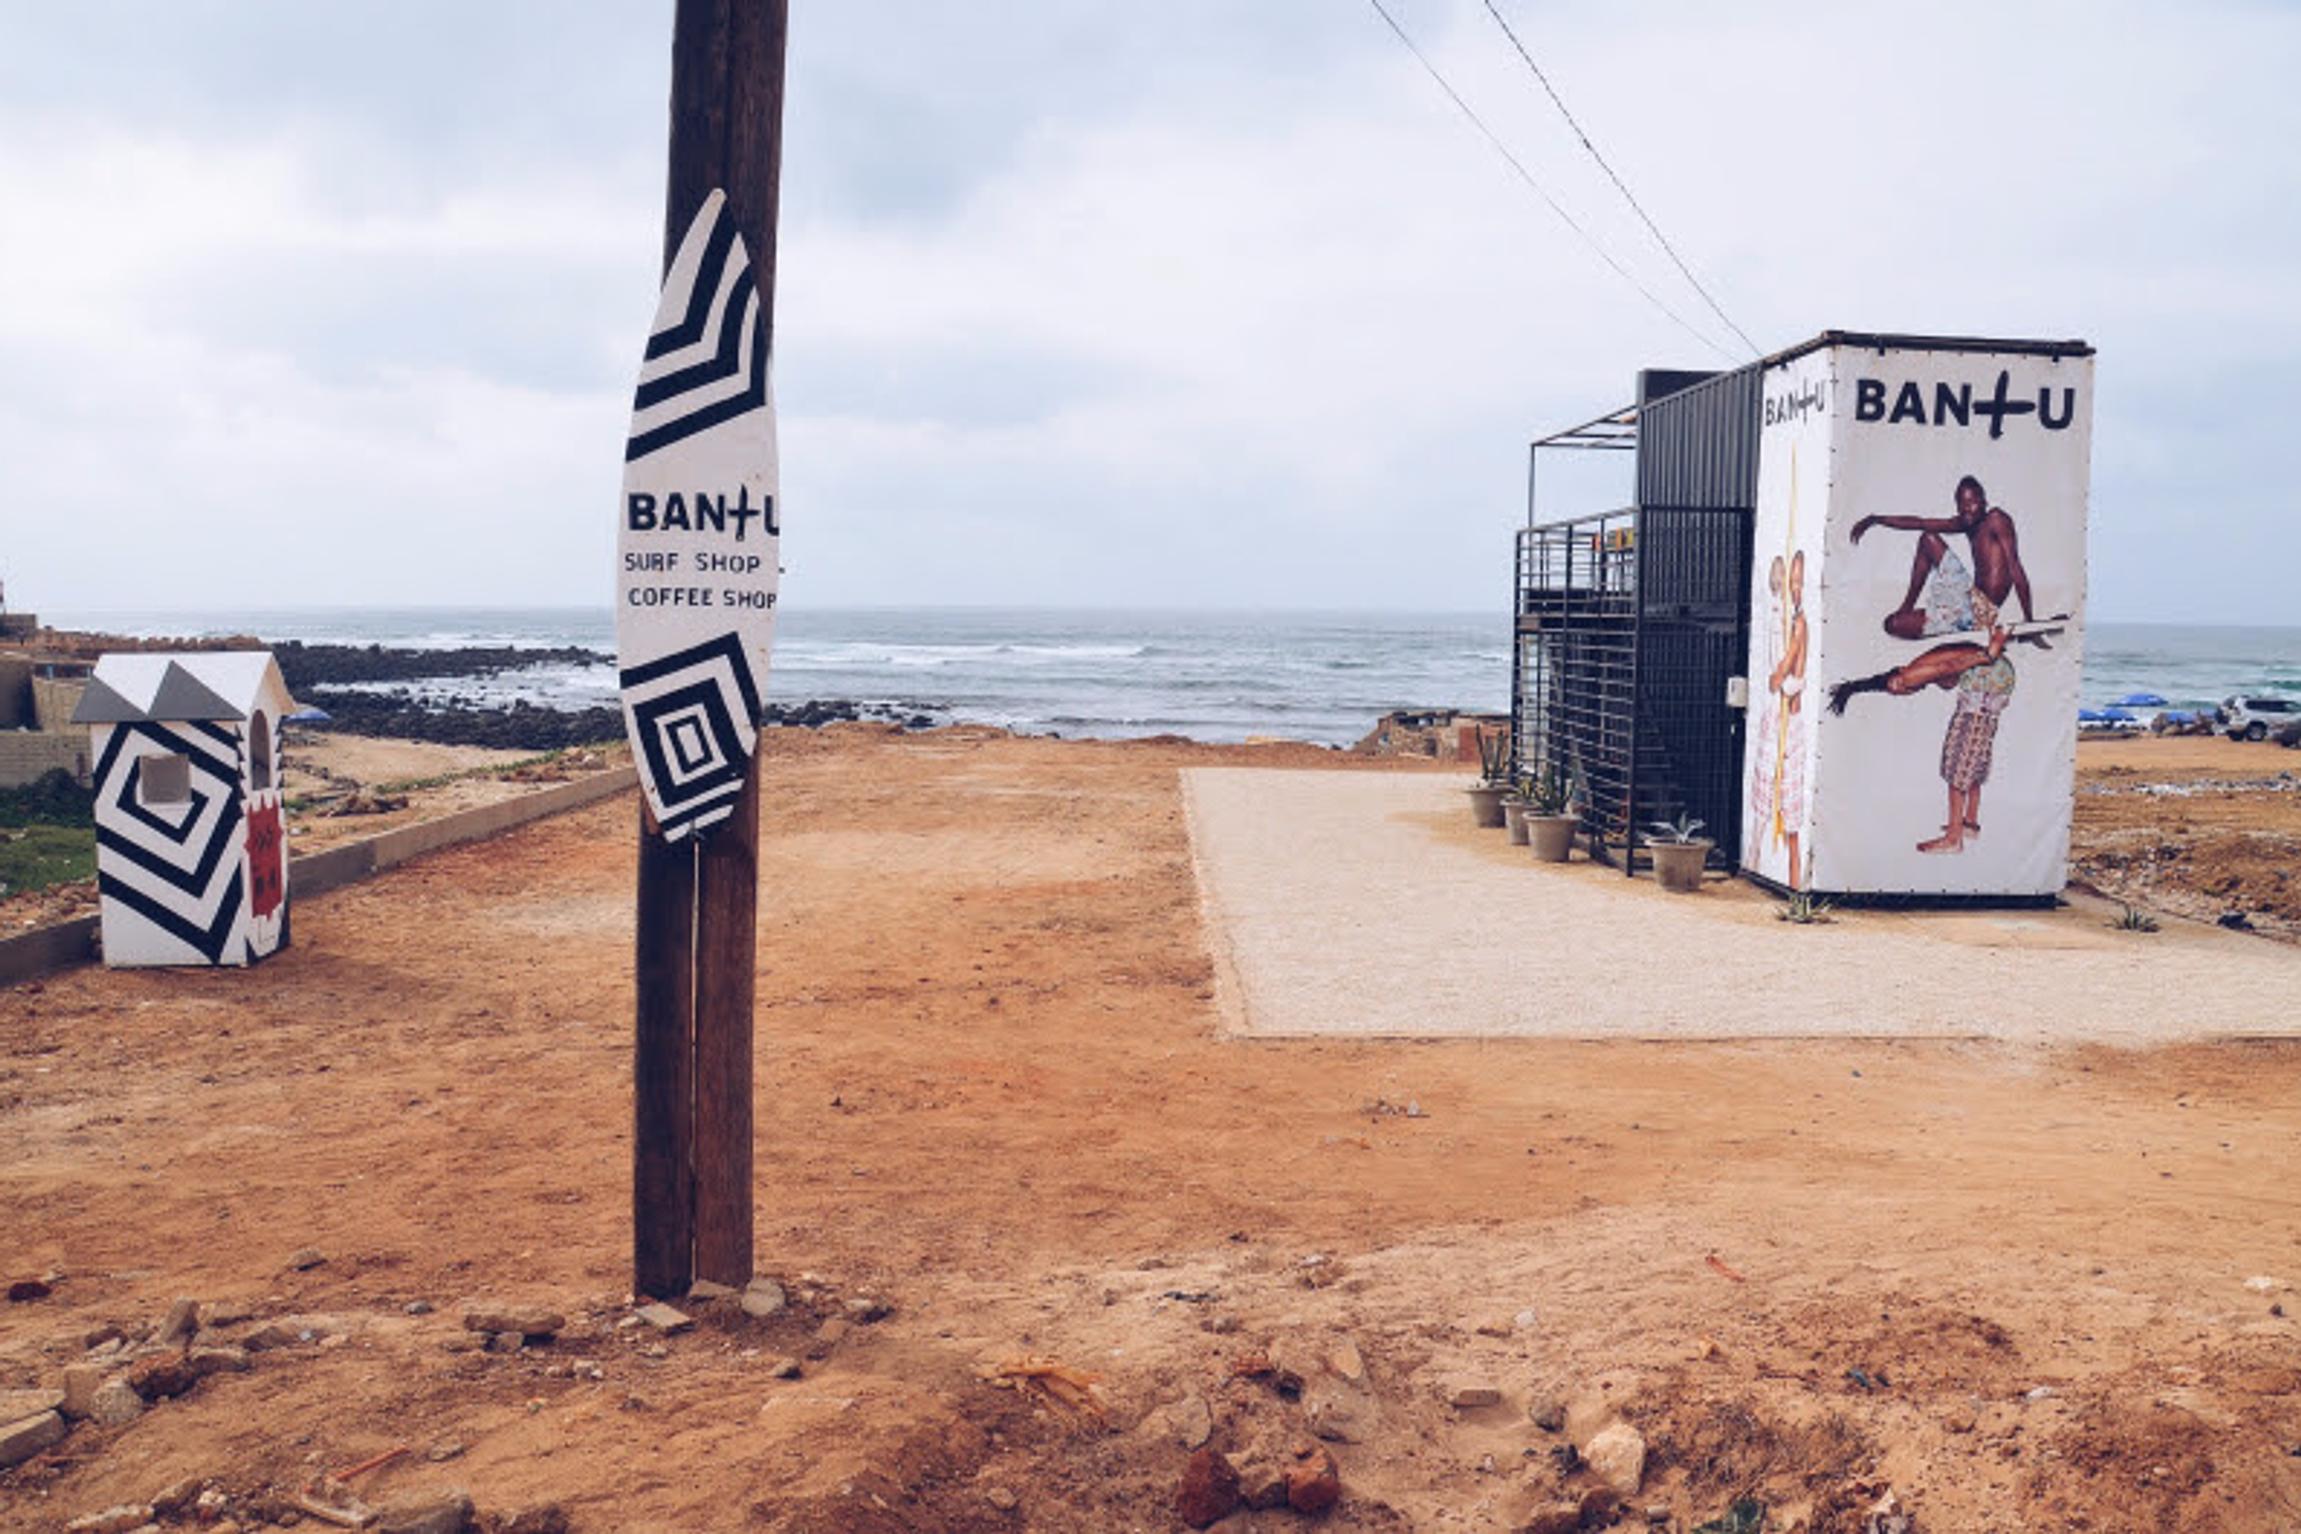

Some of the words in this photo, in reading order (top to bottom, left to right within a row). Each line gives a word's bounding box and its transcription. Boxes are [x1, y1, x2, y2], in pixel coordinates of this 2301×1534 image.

[625, 552, 679, 572] SURF
[695, 552, 761, 574] SHOP
[628, 587, 713, 607] COFFEE
[723, 589, 778, 609] SHOP
